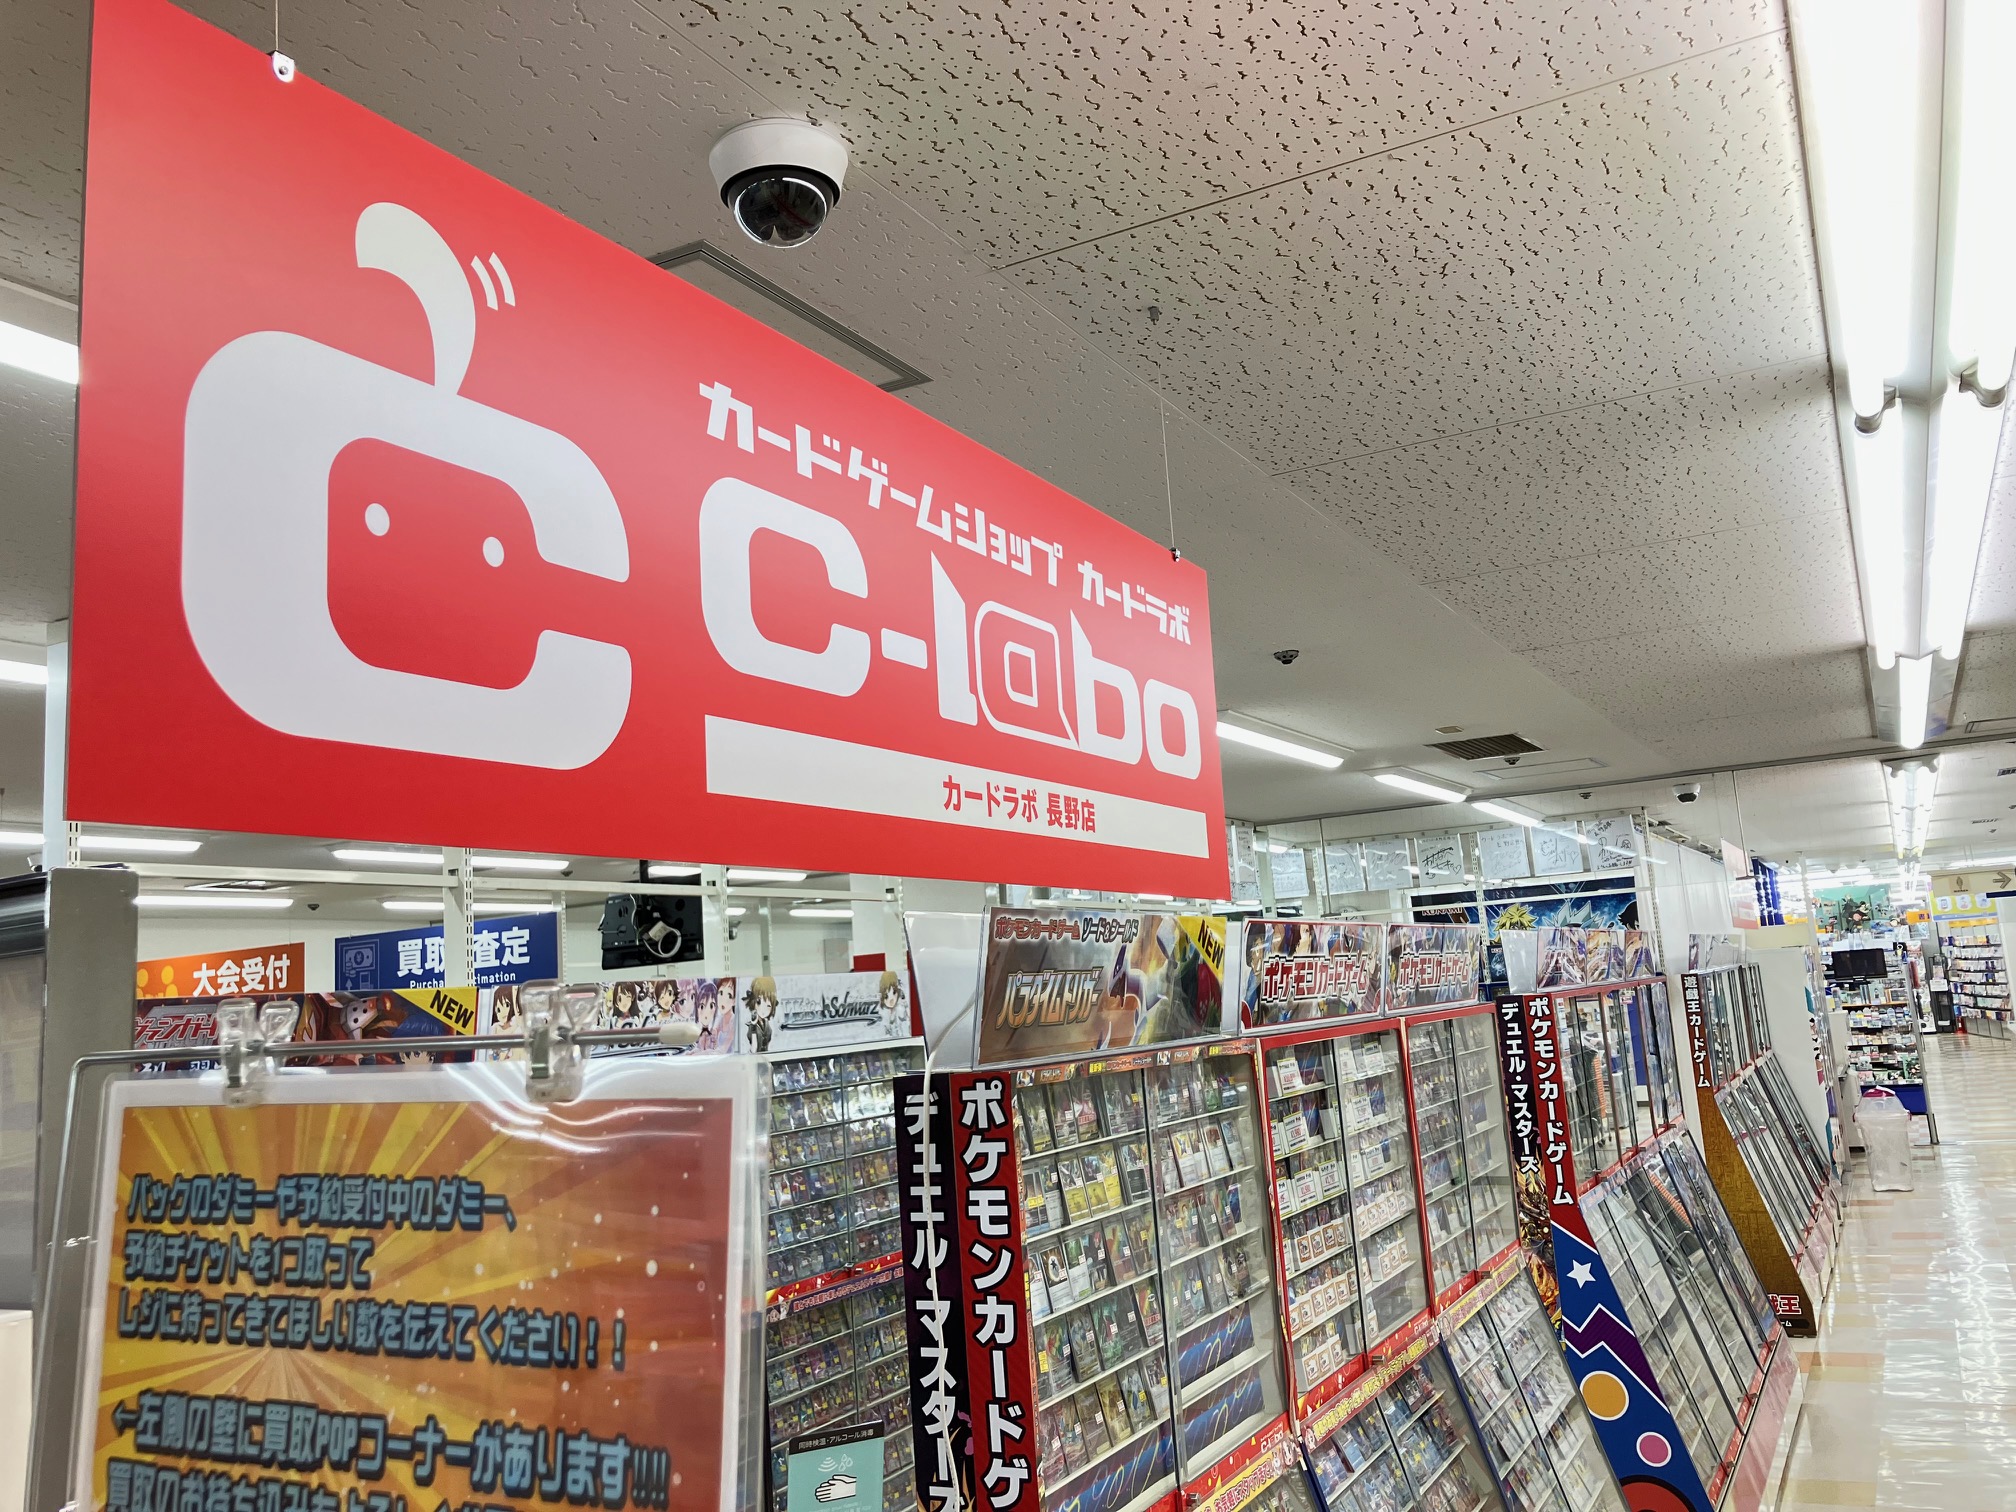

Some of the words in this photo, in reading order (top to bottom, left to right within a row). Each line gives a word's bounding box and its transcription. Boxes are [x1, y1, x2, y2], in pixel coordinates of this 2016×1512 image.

[699, 381, 1063, 586] カードゲームショップ
[1077, 560, 1191, 645] カードラボ
[943, 775, 1037, 823] カードラボ
[1047, 795, 1096, 833] 長野店
[995, 916, 1080, 940] ポケモンカードゲーム
[1198, 920, 1225, 970] NEW
[193, 956, 291, 997] 大会受付
[996, 966, 1104, 1029] パラダイムトリガー
[1262, 951, 1370, 1004] ポケモンカードゲーム
[1397, 947, 1473, 993] ポケモンカードゲーム
[429, 989, 475, 1030] NEW
[1683, 976, 1711, 1088] 遊戯王カードゲーム
[1502, 1002, 1539, 1174] デュエル・マスターズ
[1529, 997, 1575, 1206] ポケモンカードゲーム
[961, 1081, 1029, 1508] ポケモンカードゲ
